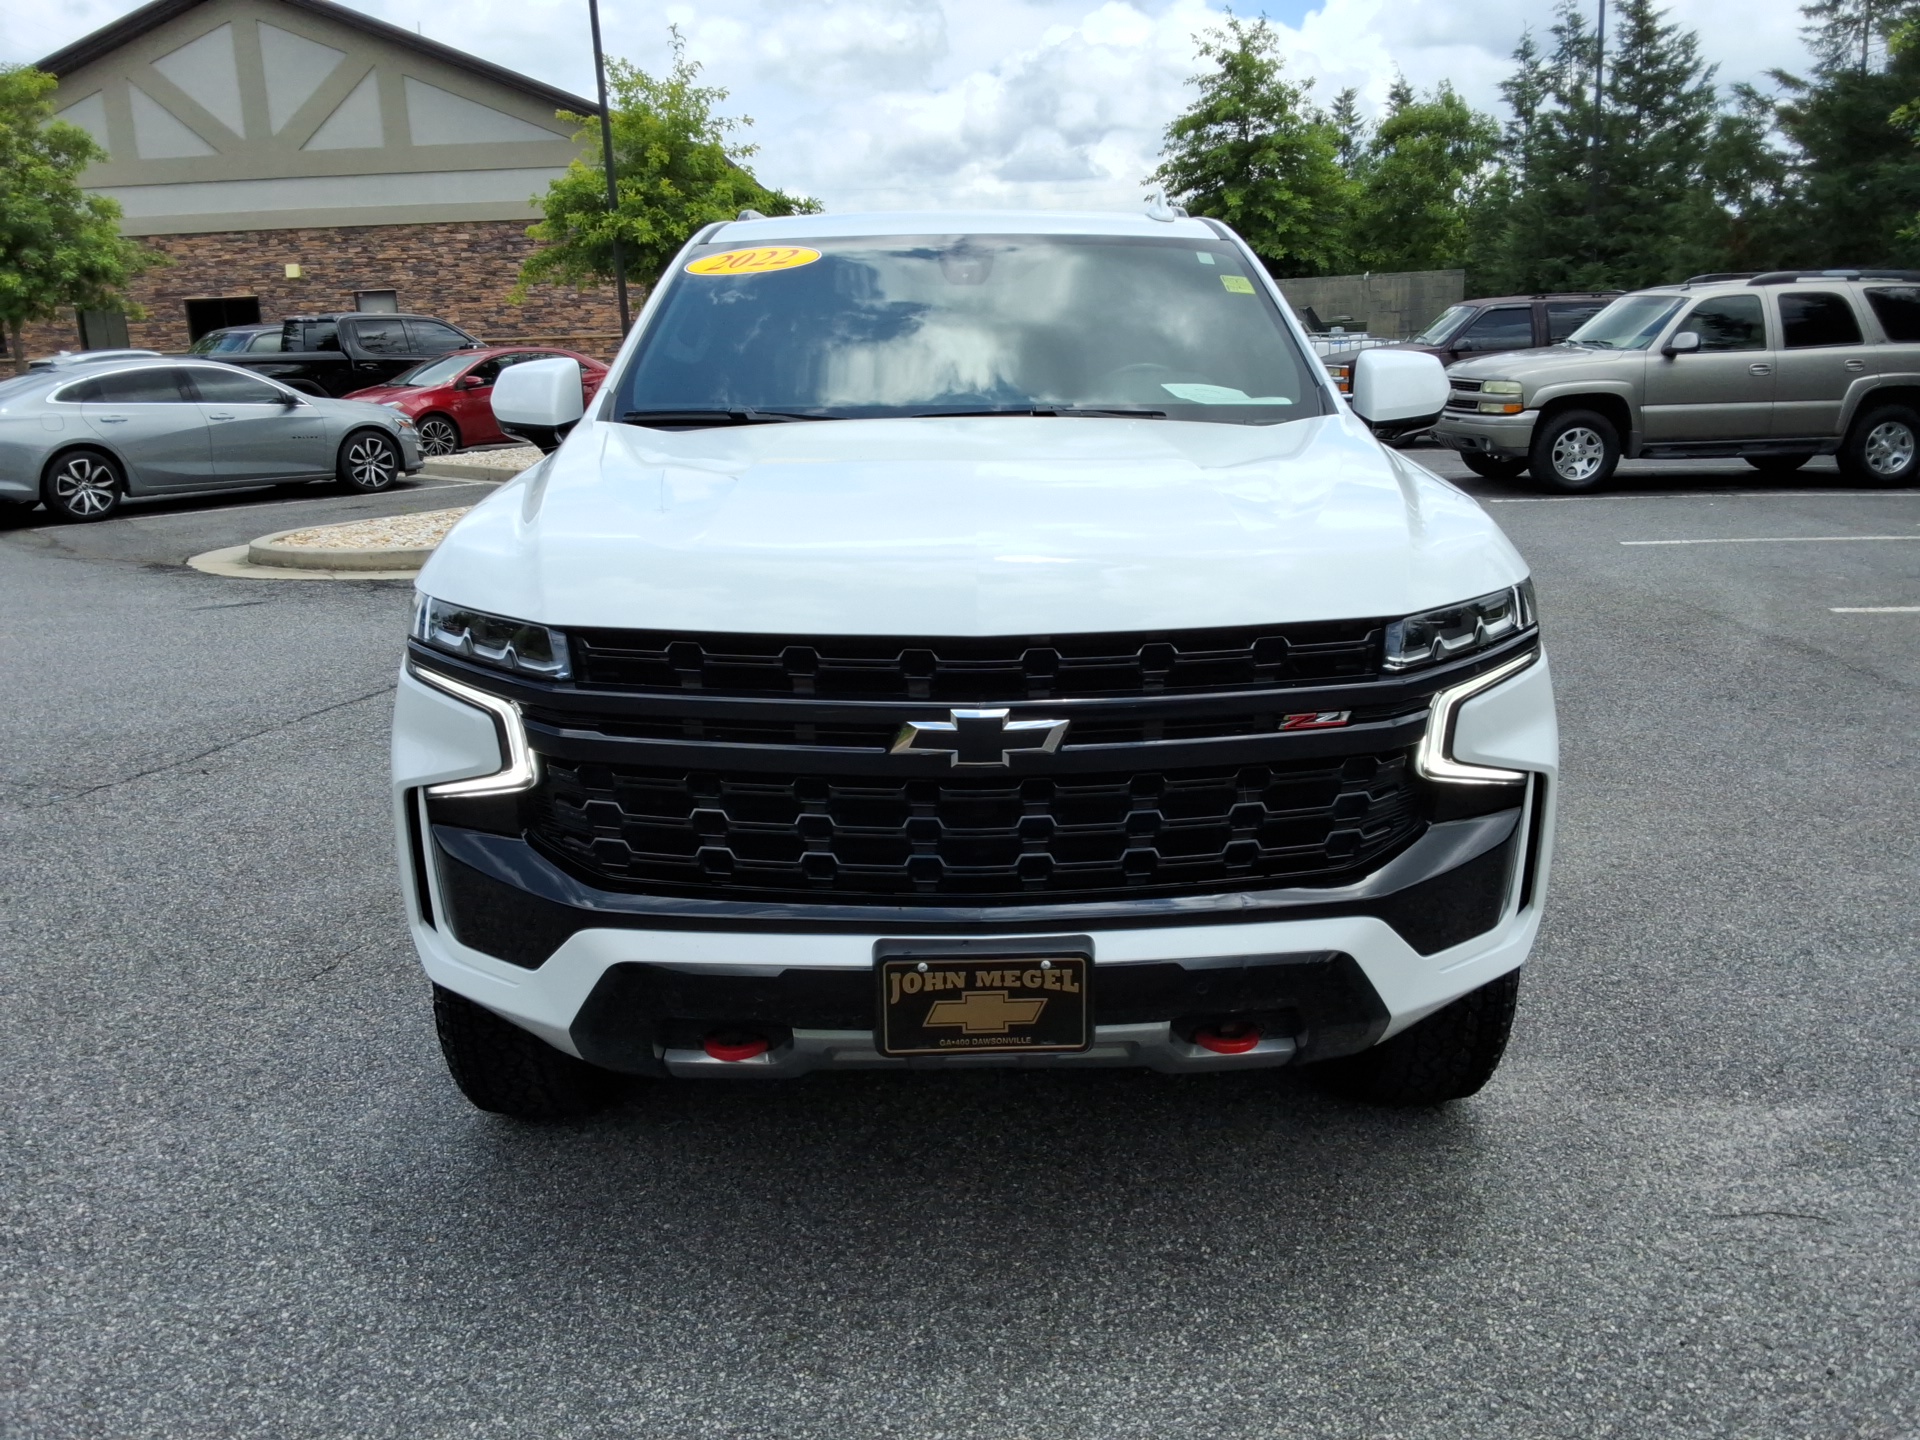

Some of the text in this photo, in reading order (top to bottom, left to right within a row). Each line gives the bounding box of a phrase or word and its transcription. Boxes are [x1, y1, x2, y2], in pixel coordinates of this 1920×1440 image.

[704, 250, 800, 271] 2022
[1278, 710, 1352, 730] Z71
[890, 969, 1080, 1004] JOHN MEGEL
[971, 1036, 1032, 1046] DAWSONVILLE
